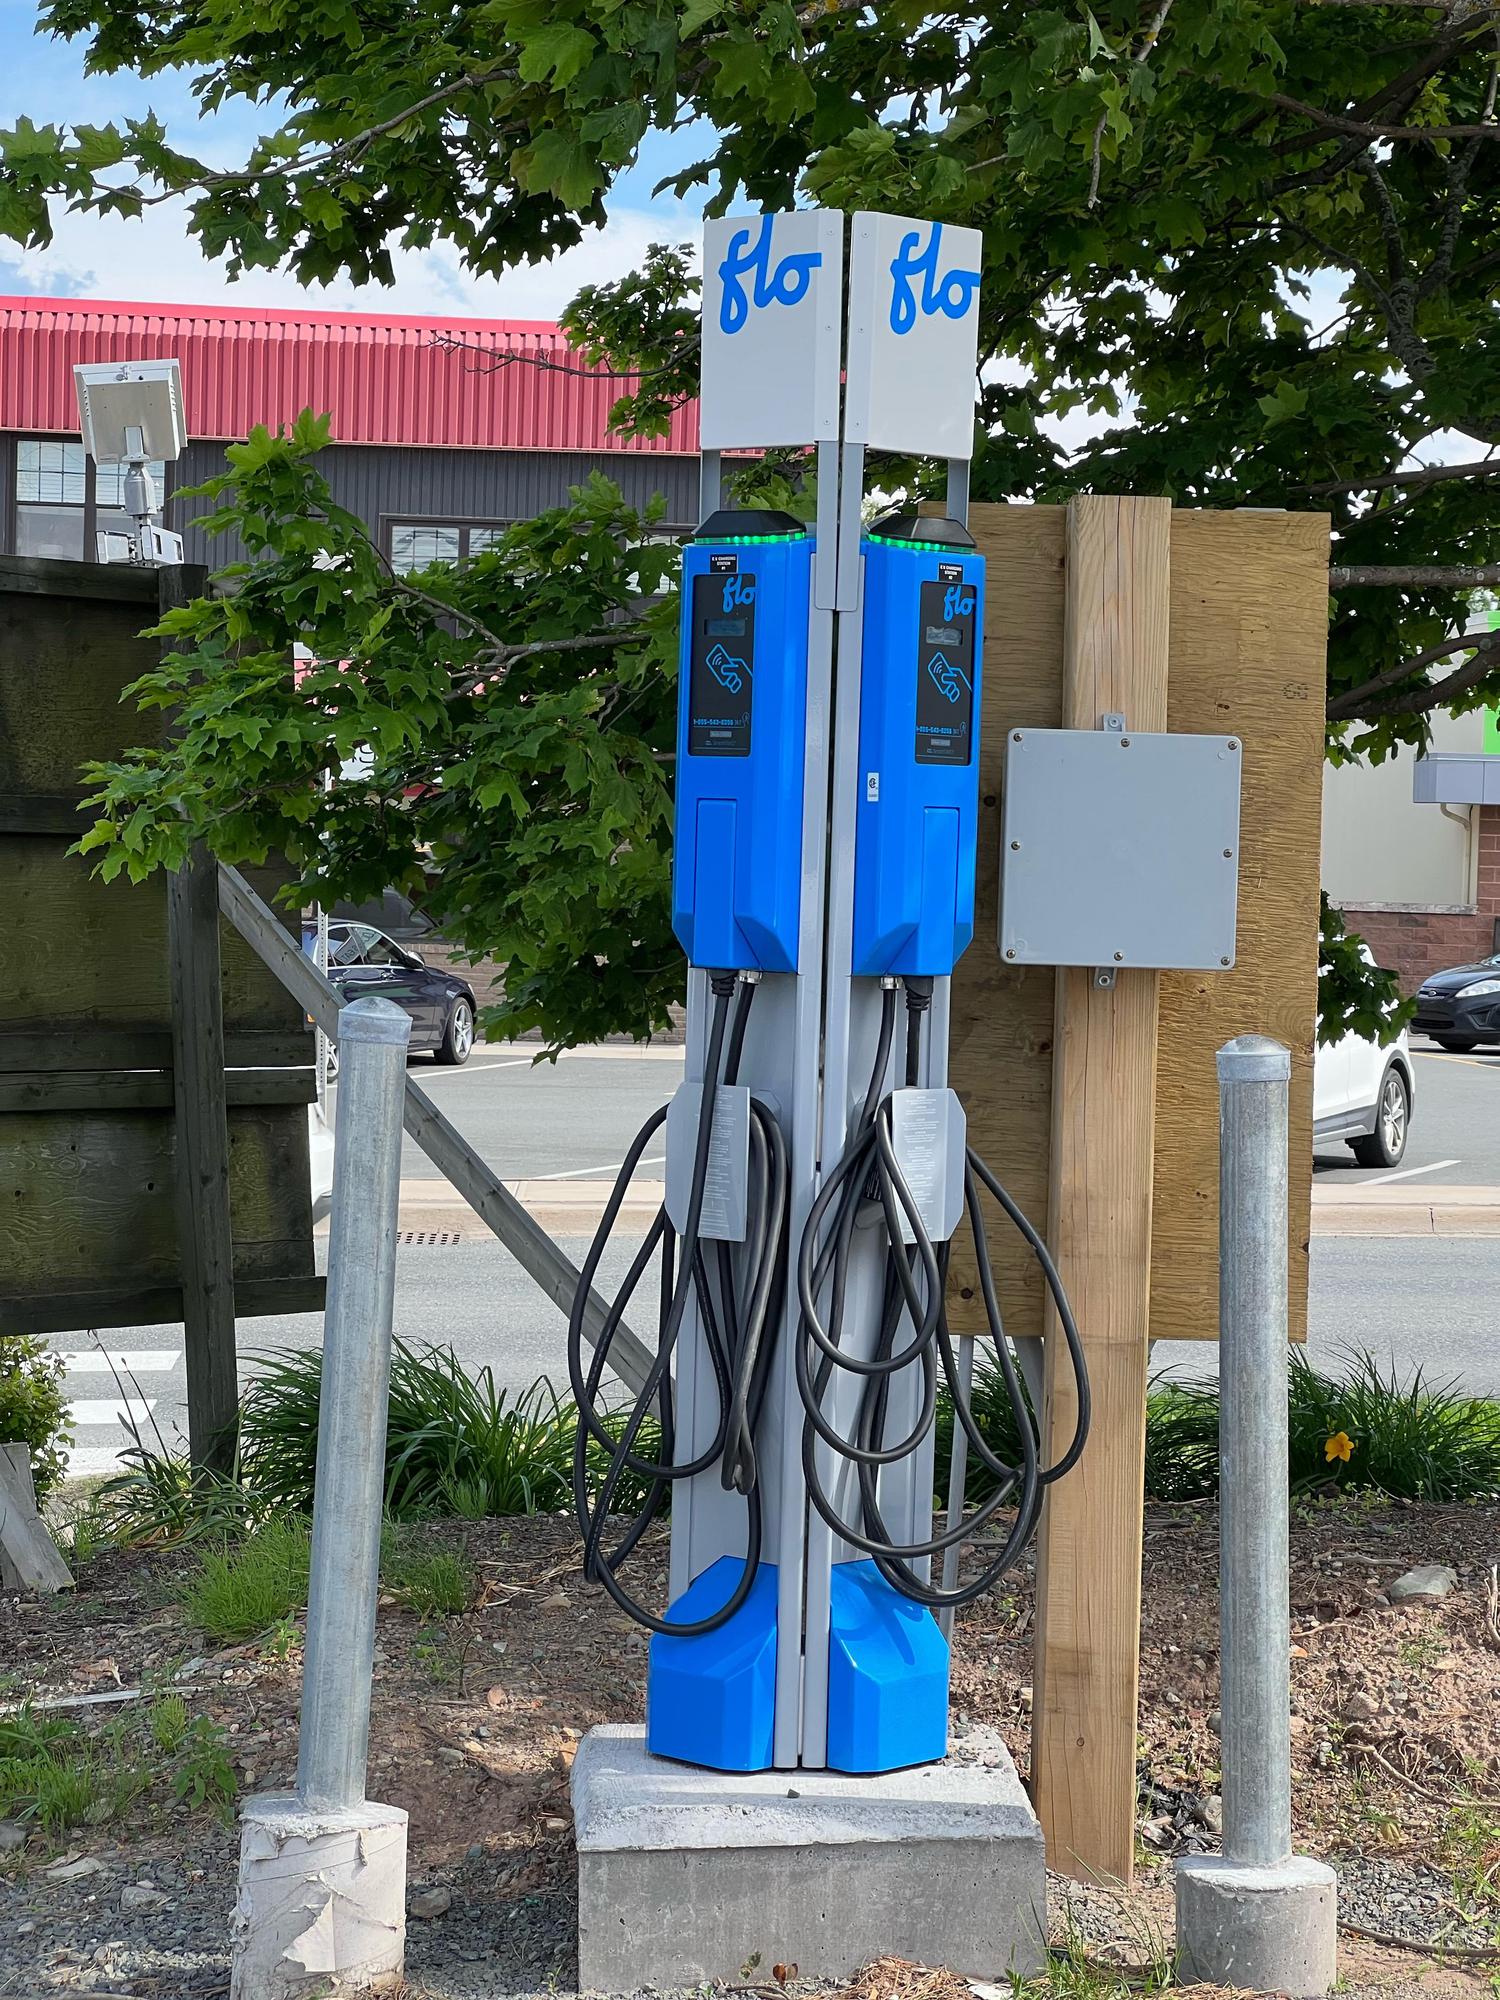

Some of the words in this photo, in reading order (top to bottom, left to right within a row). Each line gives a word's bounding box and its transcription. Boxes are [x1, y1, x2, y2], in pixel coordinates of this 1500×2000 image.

[718, 213, 823, 335] flo
[890, 221, 982, 335] flo
[723, 574, 757, 613] flo
[943, 584, 975, 622] flo
